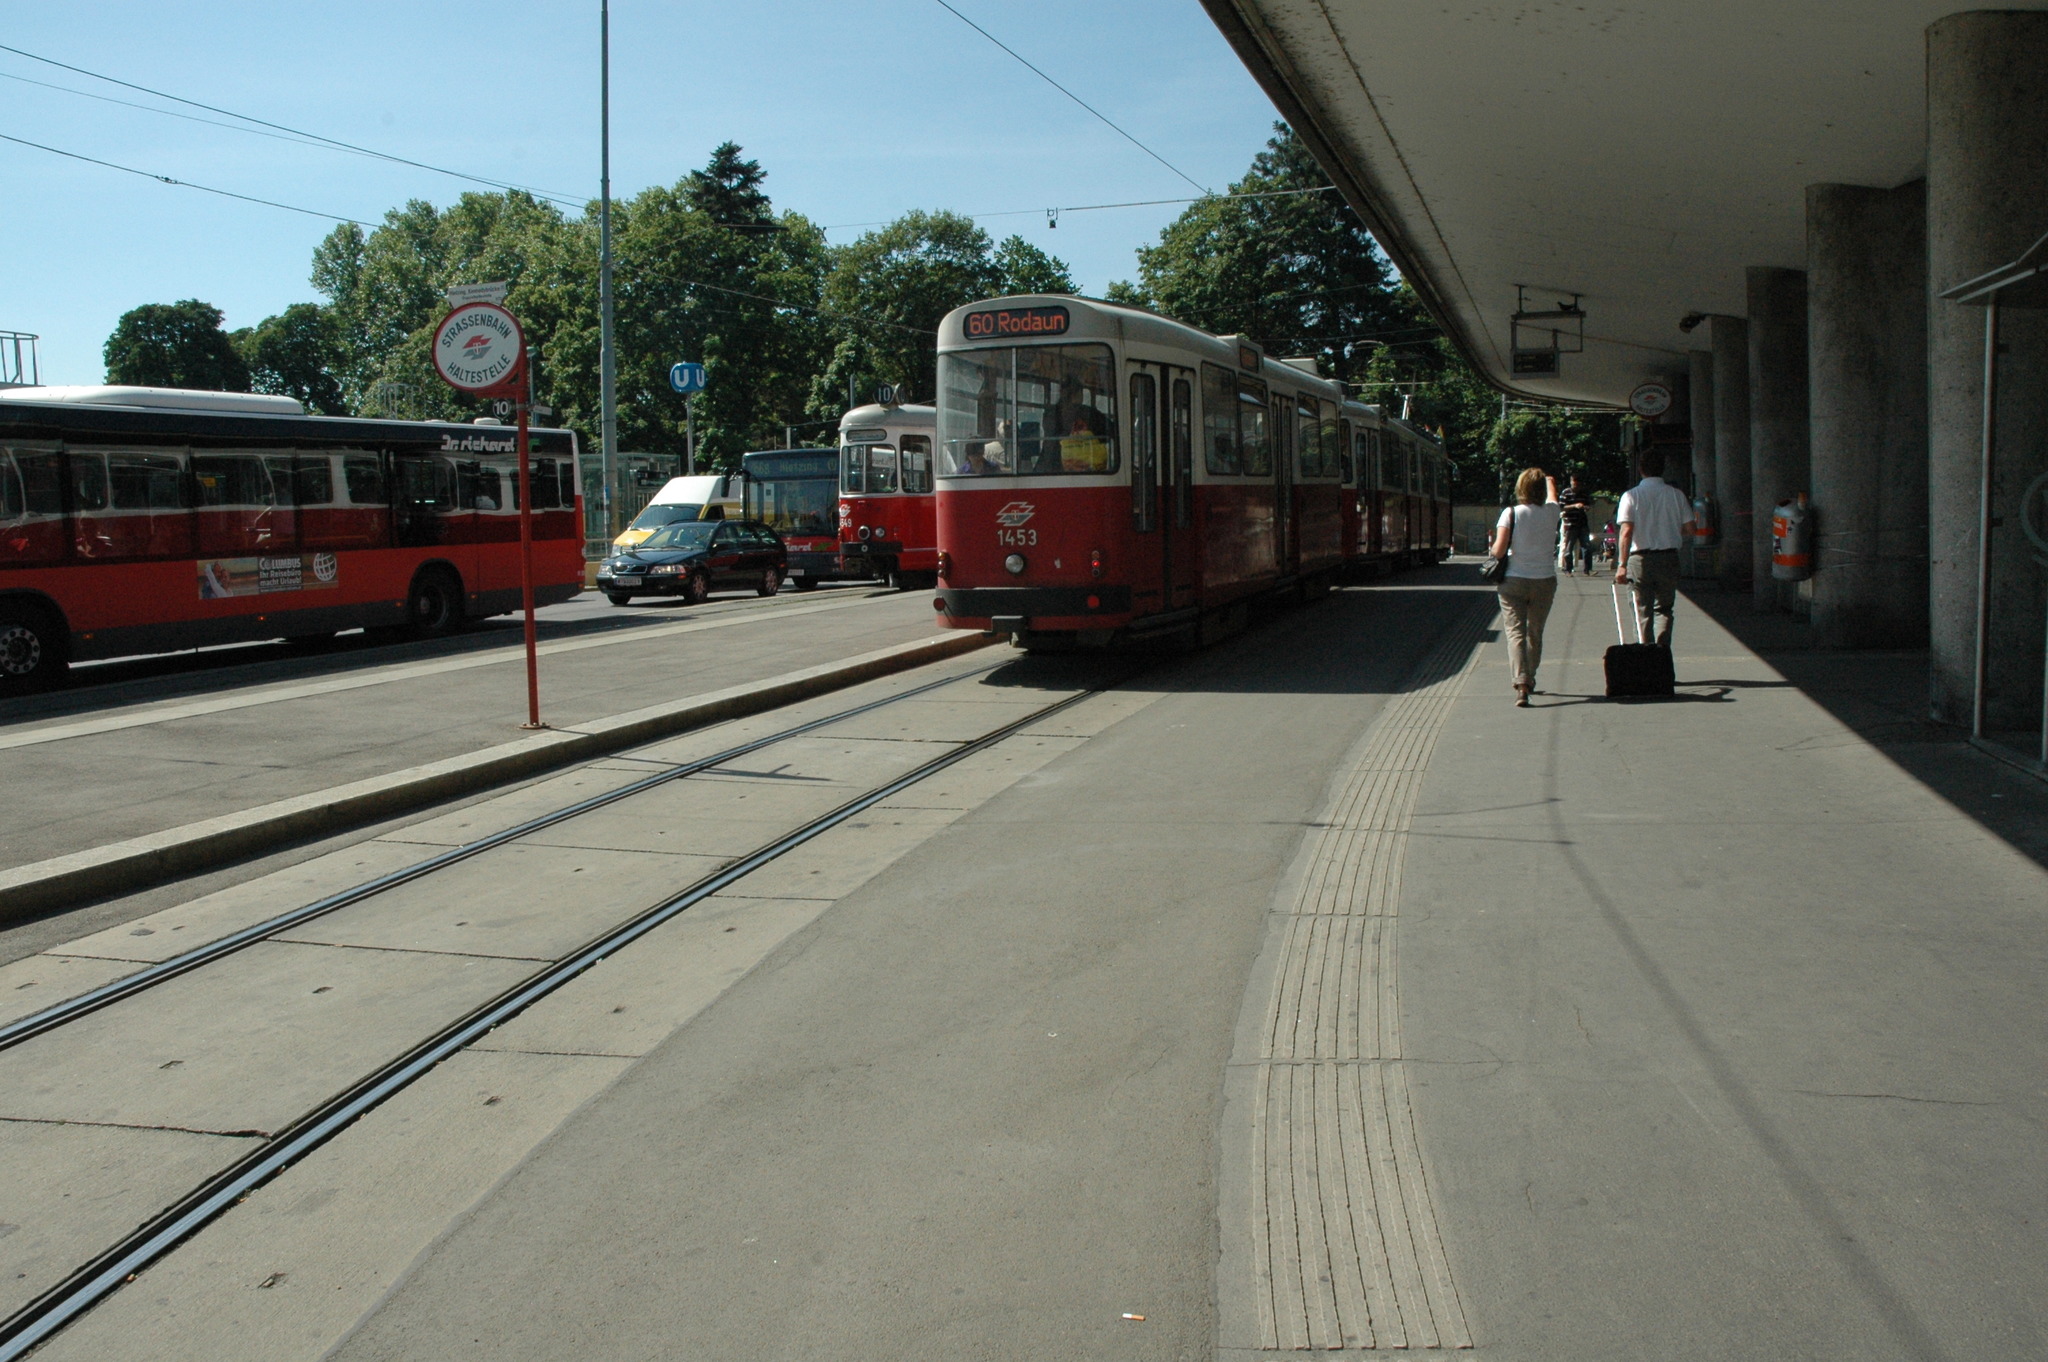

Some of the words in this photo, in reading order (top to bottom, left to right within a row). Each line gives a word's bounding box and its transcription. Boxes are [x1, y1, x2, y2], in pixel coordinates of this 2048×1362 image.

[442, 314, 512, 348] STRASSENBAHN
[969, 313, 994, 334] 60
[998, 311, 1064, 332] Rodaun
[447, 354, 510, 383] HALTESTELLE
[674, 369, 689, 387] U
[696, 369, 705, 387] U
[878, 387, 890, 400] 10
[493, 401, 509, 415] 10
[460, 435, 515, 452] richard
[997, 529, 1037, 546] 1453
[259, 571, 269, 579] Ihr
[270, 569, 302, 578] Reisebüro
[260, 578, 279, 586] macht
[280, 576, 302, 585] Urlaub!
